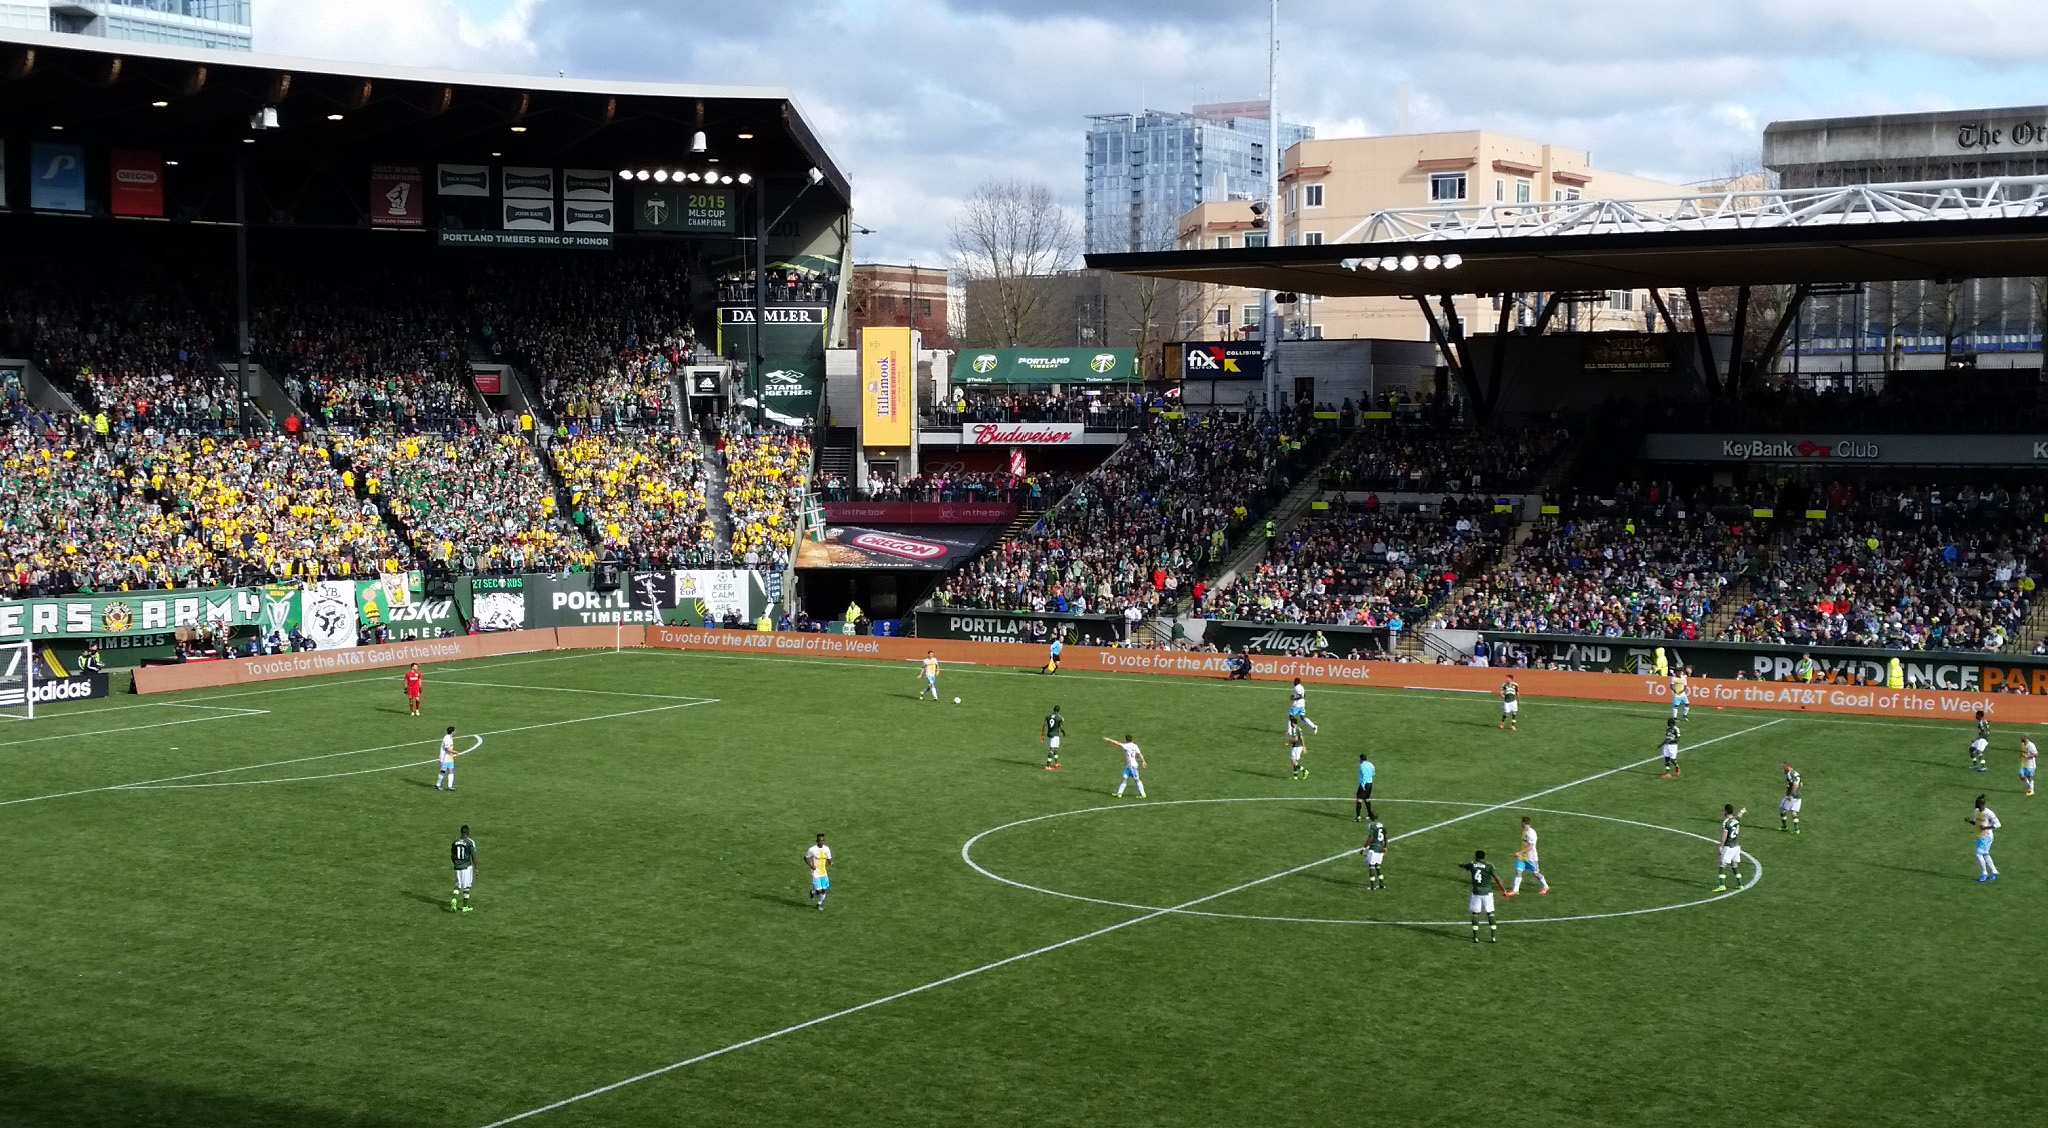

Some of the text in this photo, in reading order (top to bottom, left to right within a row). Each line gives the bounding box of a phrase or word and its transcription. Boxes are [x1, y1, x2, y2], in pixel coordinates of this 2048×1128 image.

[1958, 123, 2001, 151] The
[119, 172, 155, 180] OREGON
[688, 195, 725, 209] 2015
[688, 209, 706, 217] MLS
[688, 218, 726, 227] CHAMPIONS
[443, 233, 609, 246] PORTLAND TIMBERS RING OF HONOR
[732, 310, 812, 322] DAMLER
[1018, 357, 1070, 365] PORTLAND
[1187, 350, 1219, 369] fix
[753, 389, 812, 397] TGETHER
[877, 357, 890, 417] Tillamook
[973, 424, 1072, 445] Budweiser
[1722, 440, 1879, 459] KeyBank Club
[861, 536, 932, 555] OREGON
[471, 579, 482, 589] 27
[713, 583, 733, 591] KEEP
[325, 587, 338, 597] YB
[711, 591, 735, 599] CALM
[552, 590, 630, 610] PORTL
[715, 603, 731, 611] ARE
[142, 591, 260, 630] ARMY
[580, 610, 653, 623] TIMBERS
[660, 630, 879, 653] To vote for the AT&T Goal of the Week
[245, 640, 461, 675] To vote for the AT&T Goal of the Week
[1100, 652, 1116, 666] To
[1118, 654, 1150, 668] vote
[1153, 654, 1174, 669] for
[1176, 655, 1201, 670] the
[1280, 661, 1298, 675] of
[1299, 662, 1323, 677] the
[1327, 664, 1369, 680] Week
[1754, 656, 1979, 690] PROVIDNCE
[27, 679, 91, 700] adidas
[1645, 681, 1666, 696] To
[1714, 684, 1743, 700] for
[1744, 687, 1775, 702] the
[1778, 687, 1827, 705] AT&T
[1830, 690, 1874, 708] Goal
[1878, 692, 1901, 709] of
[1903, 694, 1936, 711] the
[1940, 696, 1995, 714] Week
[1049, 718, 1055, 728] 9
[456, 846, 465, 860] 11
[1474, 869, 1482, 883] 4
